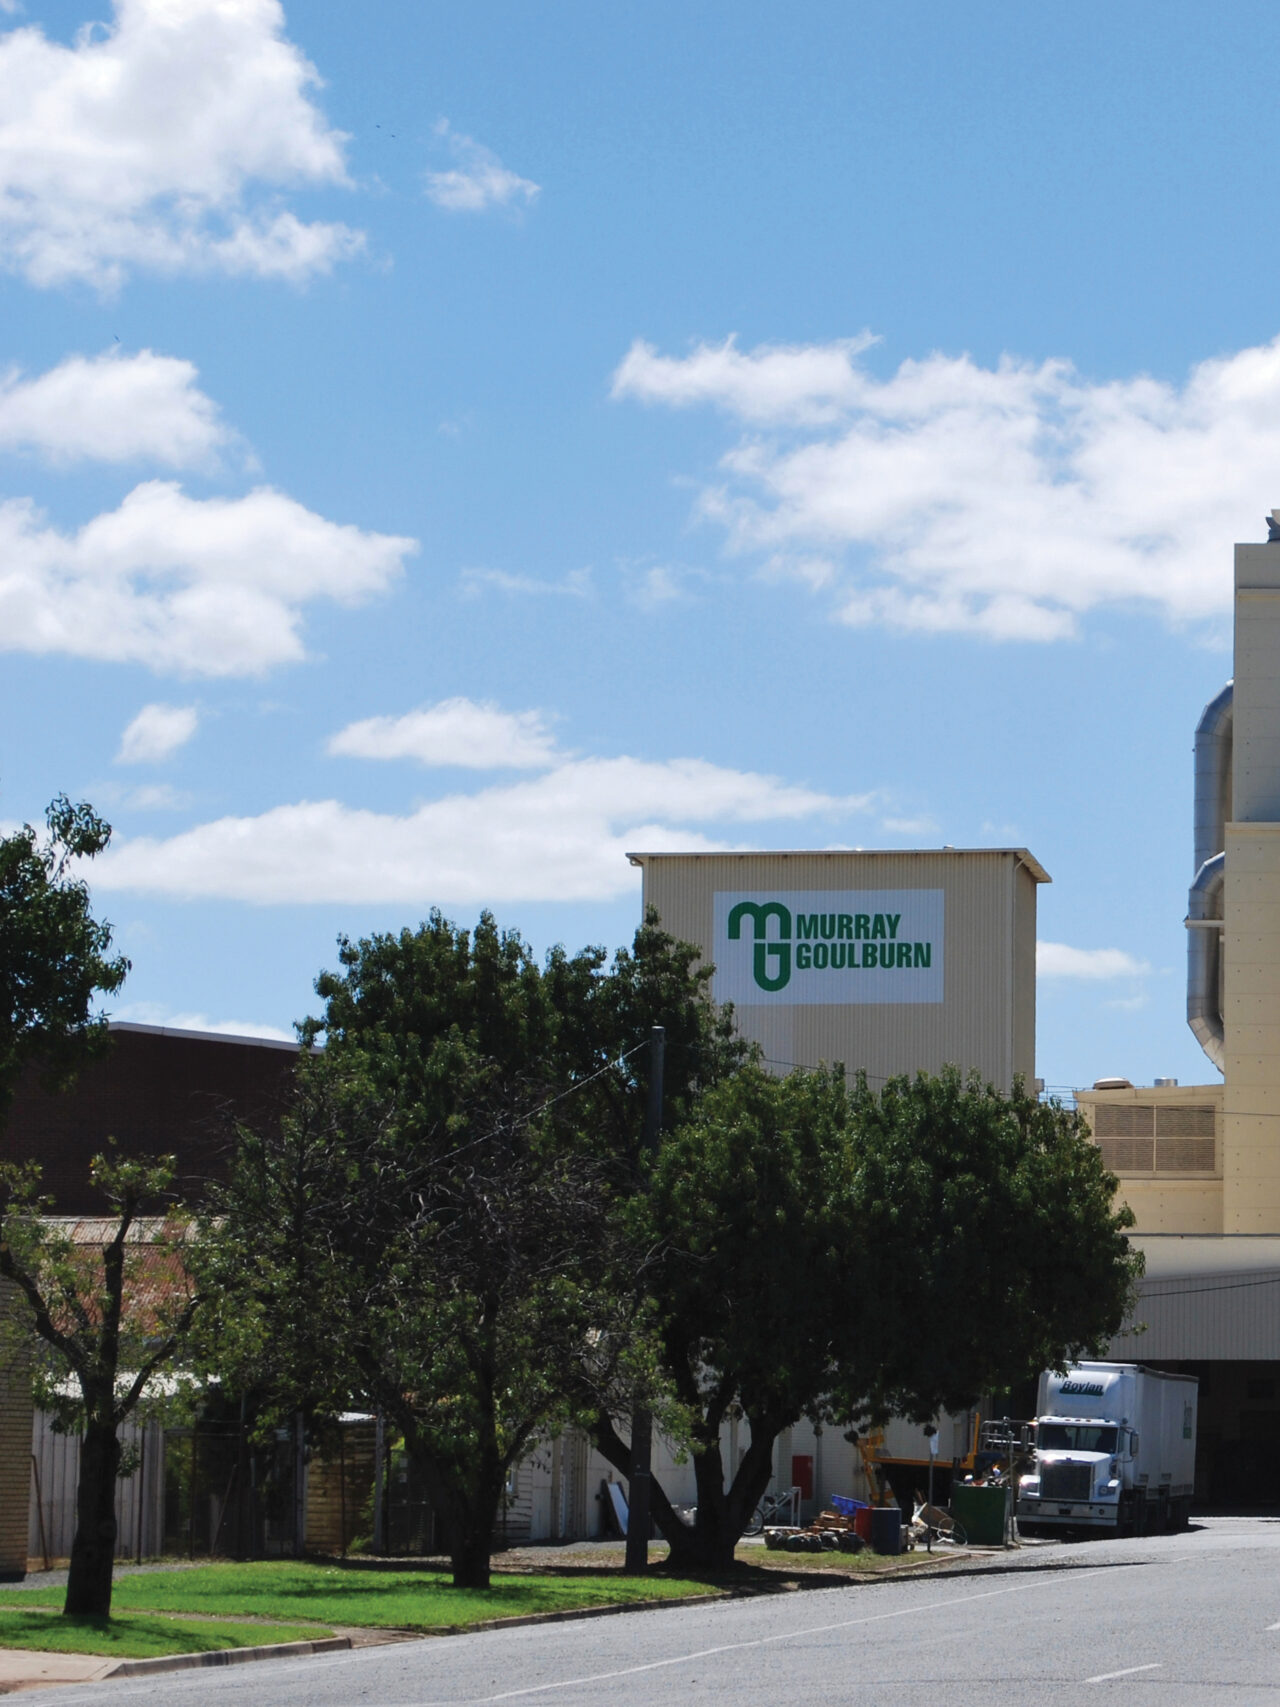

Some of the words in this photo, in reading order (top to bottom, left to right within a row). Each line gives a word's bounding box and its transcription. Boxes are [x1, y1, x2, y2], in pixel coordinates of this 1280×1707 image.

[796, 913, 901, 940] MURRAY
[795, 942, 932, 970] GOULBURN
[1062, 1380, 1104, 1394] Boylan
